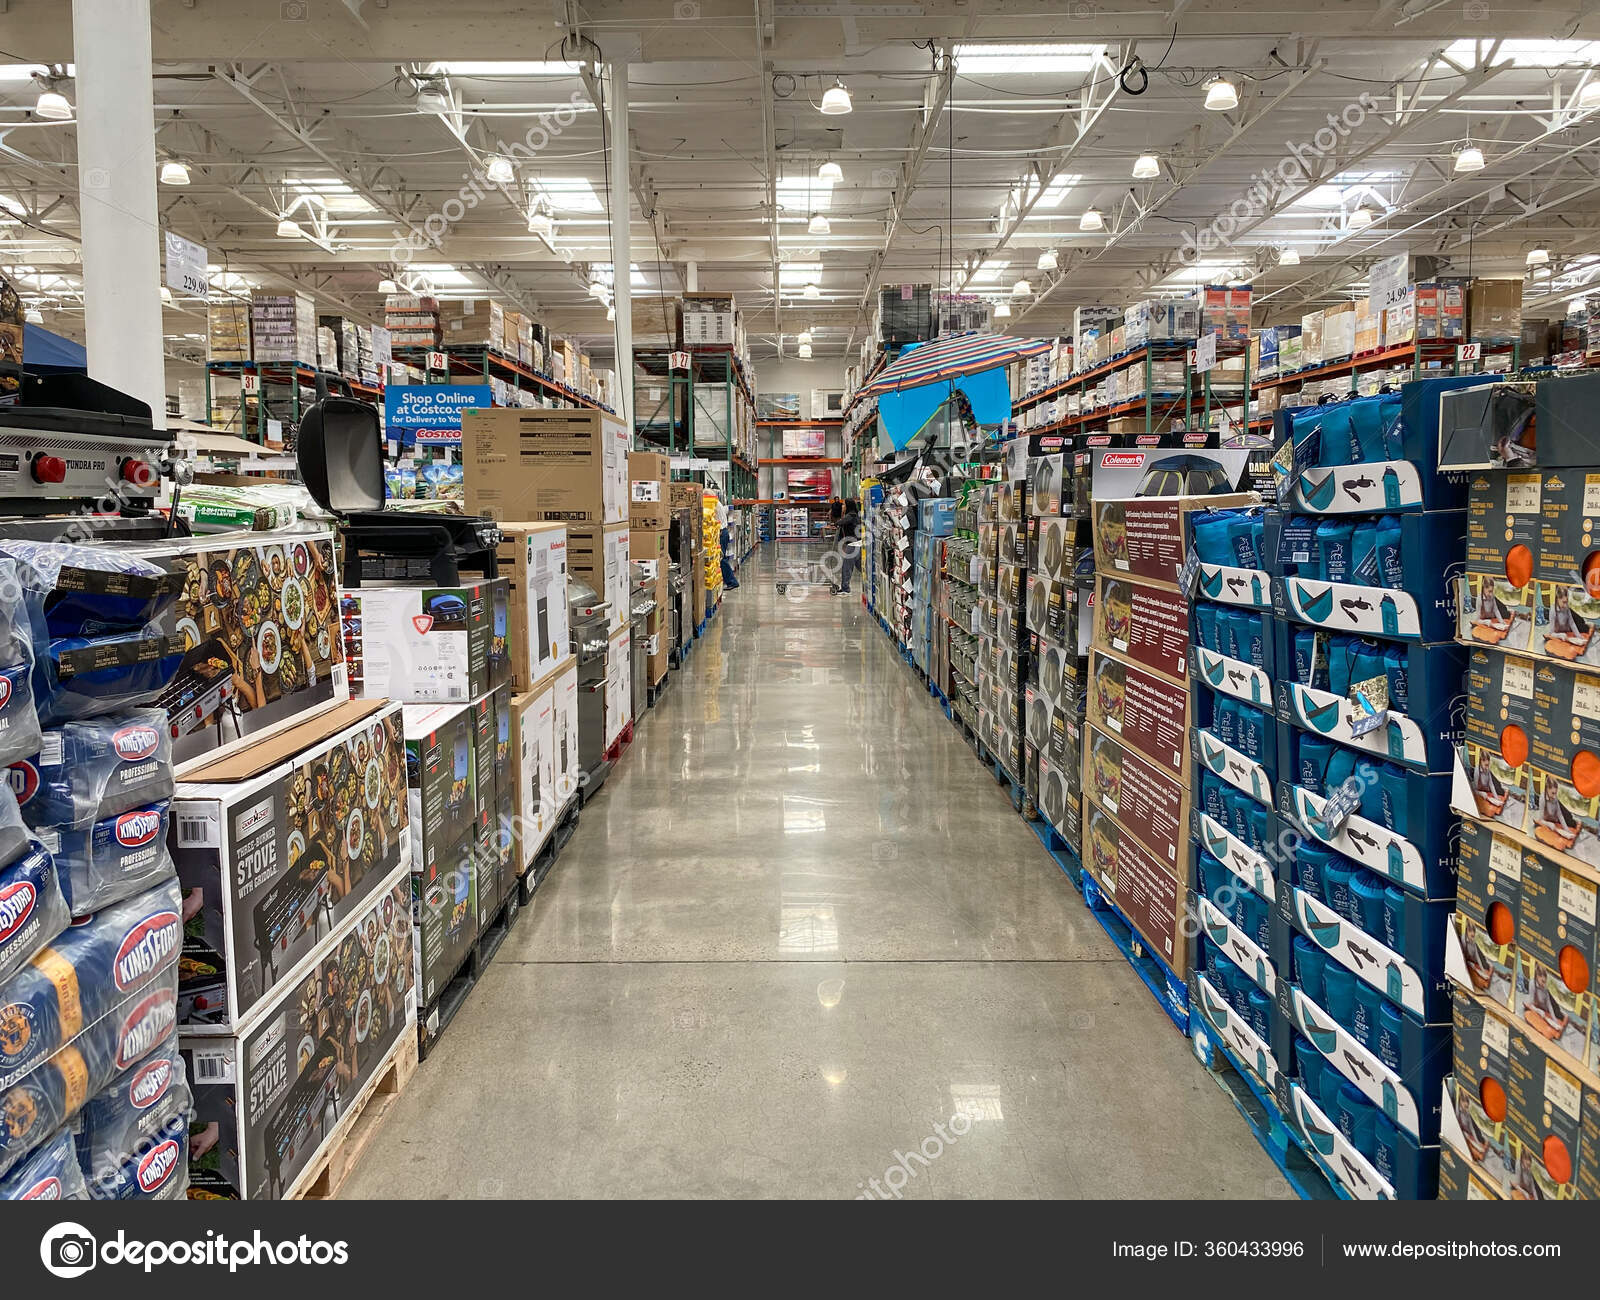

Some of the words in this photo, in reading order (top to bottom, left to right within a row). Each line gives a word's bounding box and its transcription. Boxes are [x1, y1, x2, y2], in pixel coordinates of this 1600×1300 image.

[184, 275, 207, 295] 229.99
[1386, 286, 1407, 305] 24.99
[433, 353, 443, 368] 29
[680, 353, 688, 368] 27
[1191, 350, 1197, 364] 2
[1463, 345, 1475, 360] 22
[245, 375, 255, 390] 31
[402, 393, 432, 405] Shop
[435, 393, 475, 404] Online
[396, 406, 409, 414] at
[411, 404, 479, 414] Costco.c
[405, 416, 436, 424] Delivery
[416, 428, 462, 438] COSTCO
[66, 460, 91, 470] TUNDRA
[93, 461, 105, 470] PRO
[1105, 454, 1136, 465] Coleman
[1248, 462, 1270, 472] DARK
[1447, 475, 1470, 484] WIL
[117, 731, 156, 753] KINGSFORD
[1440, 731, 1466, 740] HID
[120, 761, 159, 780] PROFESSIONAL
[119, 813, 159, 839] KINGSFORD
[236, 827, 276, 859] THREE-BURNER
[120, 845, 158, 867] PROFESSIONAL
[237, 839, 277, 886] STOVE
[40, 869, 50, 882] USA
[238, 885, 254, 899] WITH
[254, 864, 279, 888] GRIDDLE
[0, 886, 32, 930] GSFORD
[0, 918, 41, 961] OFESSIONAL
[119, 922, 178, 984] KINGSFORD
[250, 1041, 287, 1088] THREE-BURNER
[134, 1064, 170, 1102] KINGSFORD
[250, 1053, 287, 1112] STOVE
[251, 1107, 265, 1127] WITH
[265, 1078, 288, 1108] GRIDDLE
[142, 1145, 177, 1187] KINGSFORD
